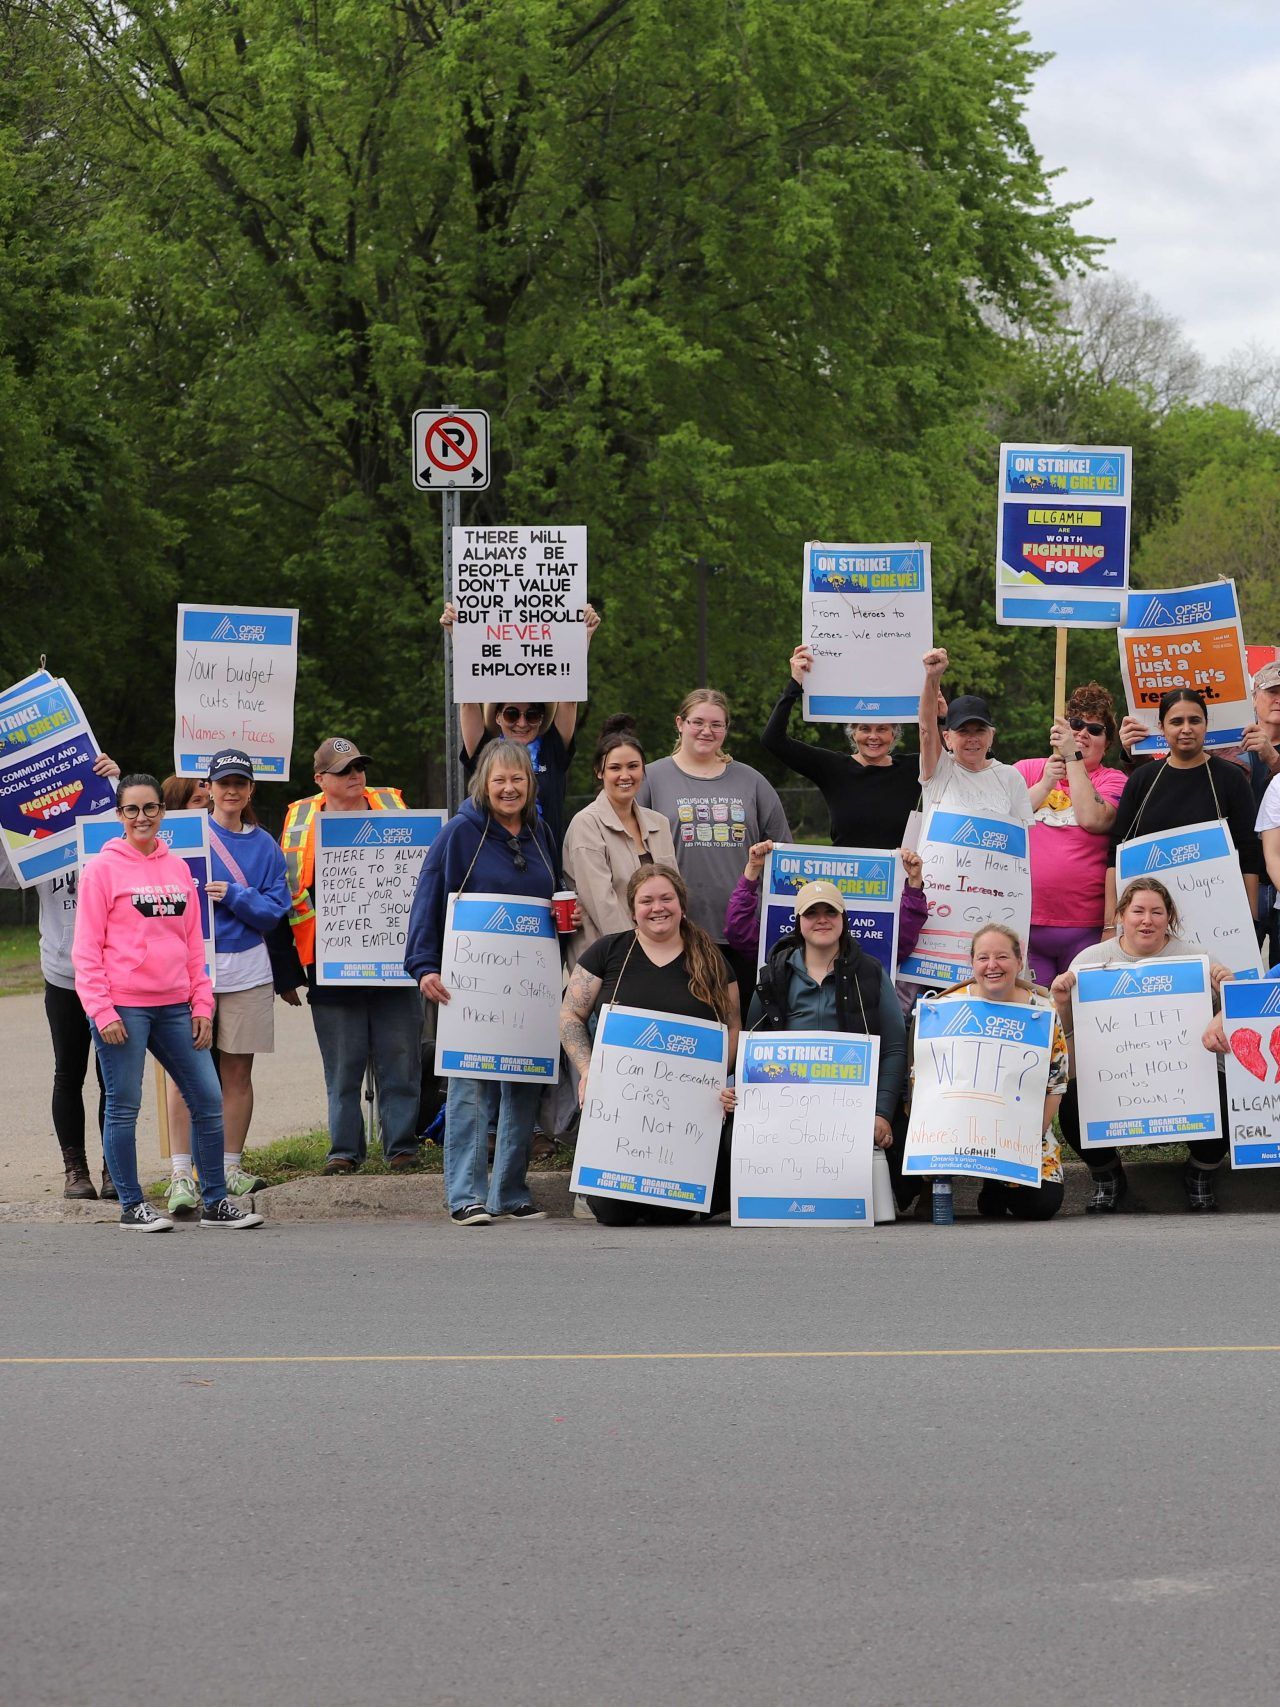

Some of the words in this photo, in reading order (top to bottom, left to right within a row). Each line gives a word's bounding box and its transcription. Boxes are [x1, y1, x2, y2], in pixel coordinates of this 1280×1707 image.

[1015, 458, 1034, 471] ON
[1038, 458, 1090, 472] STRIKE!
[1033, 511, 1083, 524] LLGAMH
[465, 531, 518, 543] THERE
[463, 547, 527, 560] ALWAYS
[544, 547, 564, 559] BE
[1022, 544, 1104, 557] FIGHTING
[459, 564, 524, 577] PEOPLE
[536, 563, 578, 576] THAT
[818, 557, 835, 571] ON
[839, 557, 891, 571] STRIKE!
[1045, 560, 1080, 573] FOR
[459, 579, 509, 592] DON'T
[519, 579, 571, 591] VALUE
[456, 595, 503, 608] YOUR
[515, 595, 565, 608] WORK
[1175, 601, 1212, 614] OPSEU
[457, 610, 490, 624] BUT
[520, 610, 584, 623] SHOULD
[1176, 612, 1212, 624] SEFPO
[238, 633, 264, 641] SEFPO
[239, 625, 266, 634] OPSEU
[487, 624, 551, 640] NEVER
[852, 629, 871, 639] We
[482, 644, 501, 657] BE
[521, 645, 553, 657] THE
[1167, 639, 1202, 656] not
[186, 648, 218, 682] Your
[227, 656, 276, 693] budget
[1134, 658, 1172, 676] just
[1178, 659, 1189, 671] a
[1137, 673, 1190, 689] raise,
[200, 689, 229, 708] cuts
[238, 691, 267, 713] have
[182, 714, 225, 741] Names
[241, 720, 275, 744] Faces
[2, 757, 55, 784] COMMUNITY
[58, 746, 77, 761] AND
[30, 761, 71, 785] SERVICES
[72, 753, 89, 767] ARE
[34, 780, 62, 797] WORTH
[19, 780, 84, 815] FIGHTING
[43, 801, 71, 820] FOR
[382, 835, 411, 844] SEFPO
[383, 828, 413, 836] OPSEU
[322, 849, 365, 863] THERE
[956, 850, 972, 868] We
[985, 853, 1008, 871] Have
[322, 866, 357, 877] GOING
[368, 864, 384, 874] TO
[394, 863, 408, 874] BE
[781, 859, 800, 873] ON
[804, 860, 858, 877] STRIKE!
[322, 878, 365, 890] PEOPLE
[376, 877, 401, 887] WHO
[1177, 874, 1225, 898] Wages
[131, 894, 187, 904] FIGHTING
[323, 891, 356, 904] VALUE
[367, 889, 393, 904] YOUR
[153, 904, 176, 915] FOR
[322, 905, 346, 916] BUT
[325, 918, 373, 932] NEVER
[853, 918, 875, 927] AND
[864, 931, 883, 939] ARE
[322, 935, 352, 953] YOUR
[454, 935, 527, 967] Burnout
[986, 1015, 1026, 1030] OPSEU
[1095, 1015, 1120, 1034] We
[1134, 1008, 1184, 1028] LIFT
[984, 1026, 1024, 1041] SEFPO
[1116, 1037, 1151, 1054] others
[754, 1046, 773, 1060] ON
[777, 1046, 833, 1061] STRIKE!
[616, 1055, 644, 1076] Can
[930, 1041, 1040, 1102] WTF?
[1145, 1059, 1188, 1076] HOLD
[780, 1086, 821, 1118] Sign
[589, 1099, 621, 1124] But
[642, 1115, 675, 1134] Not
[1234, 1124, 1272, 1142] REAL
